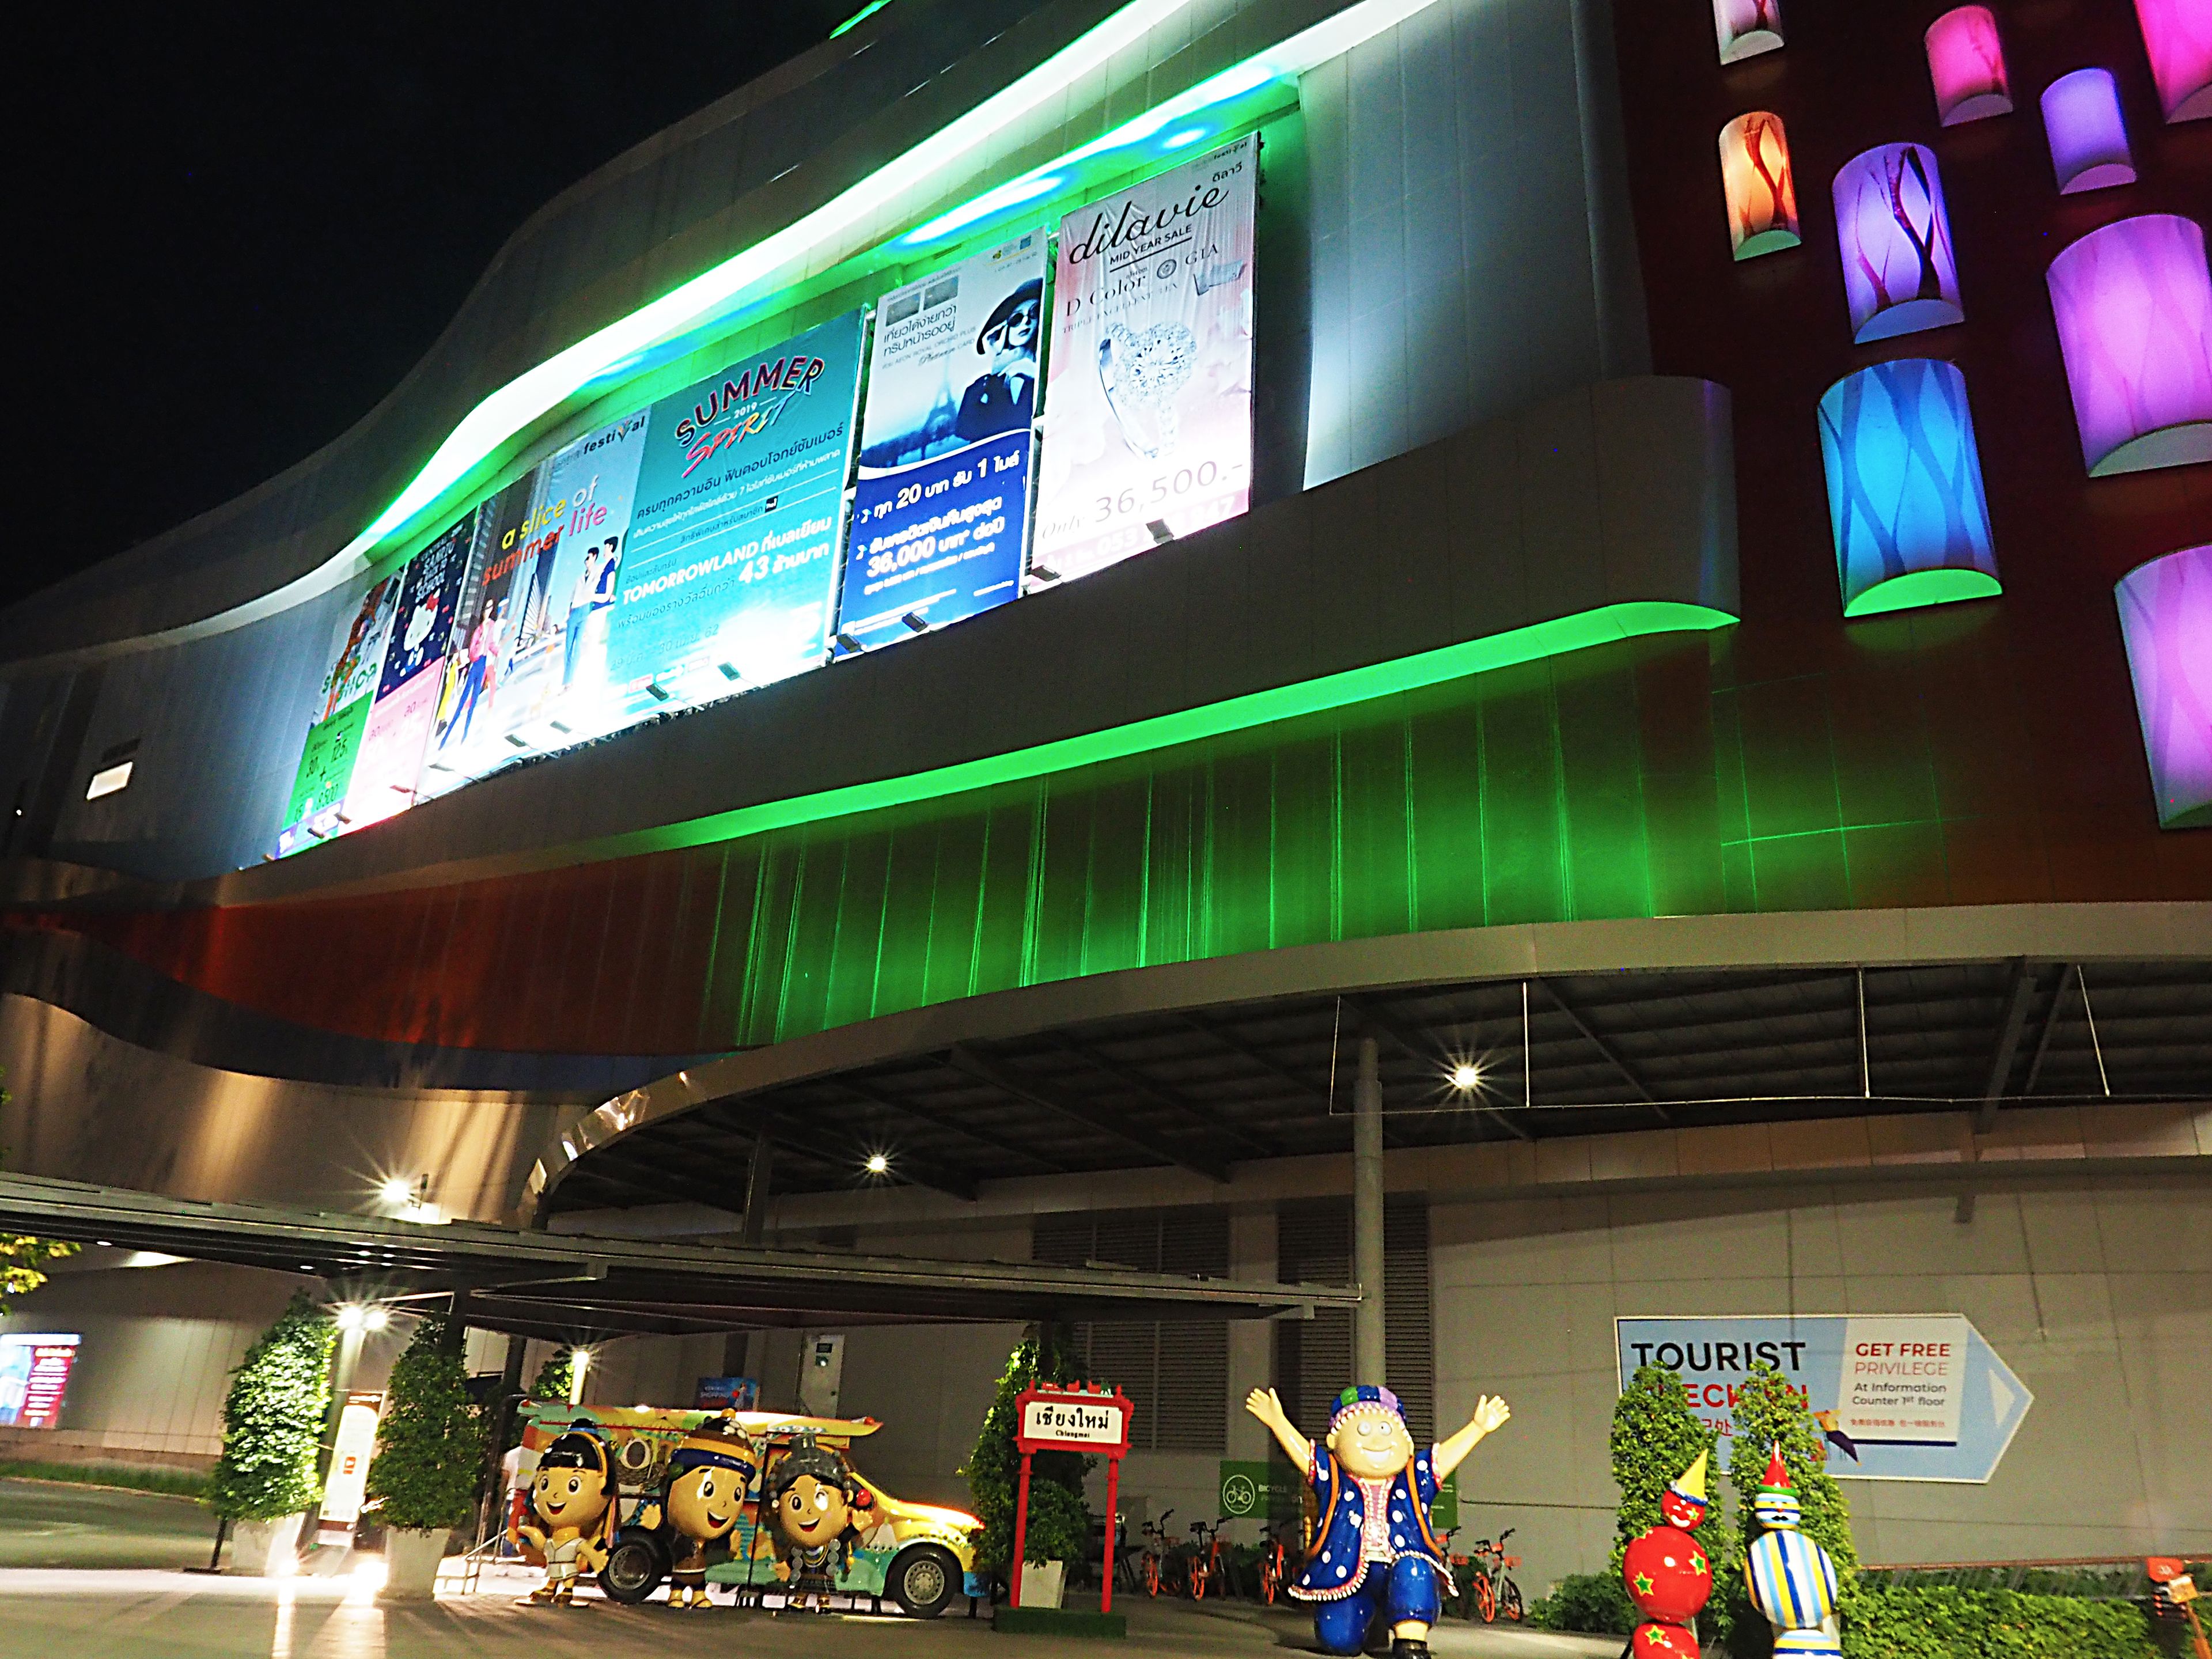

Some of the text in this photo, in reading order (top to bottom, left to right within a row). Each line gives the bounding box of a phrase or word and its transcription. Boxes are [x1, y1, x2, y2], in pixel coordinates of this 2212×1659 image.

[1069, 185, 1229, 265] dilavie
[1109, 224, 1192, 265] MID YEAR SALE
[1090, 275, 1146, 305] Color
[676, 356, 825, 448] SUMMER
[733, 402, 757, 419] 2019
[682, 391, 797, 478] SPIRIT
[637, 477, 721, 520] ครบทุกความอิน
[896, 483, 923, 510] 20
[977, 457, 988, 479] 1
[502, 475, 600, 551] a slice of
[482, 525, 565, 586] summer
[569, 502, 608, 537] life
[623, 541, 759, 605] TOMORROWLAND
[738, 555, 770, 585] 43
[1630, 1342, 1806, 1372] TOURIST
[1855, 1343, 1951, 1357] GET FREE
[1854, 1362, 1949, 1376] PRIVILEGE
[1852, 1396, 1899, 1406] Counter
[1918, 1396, 1945, 1406] floor
[1854, 1382, 1947, 1393] At Information
[1035, 1405, 1109, 1429] เชียงใหม่
